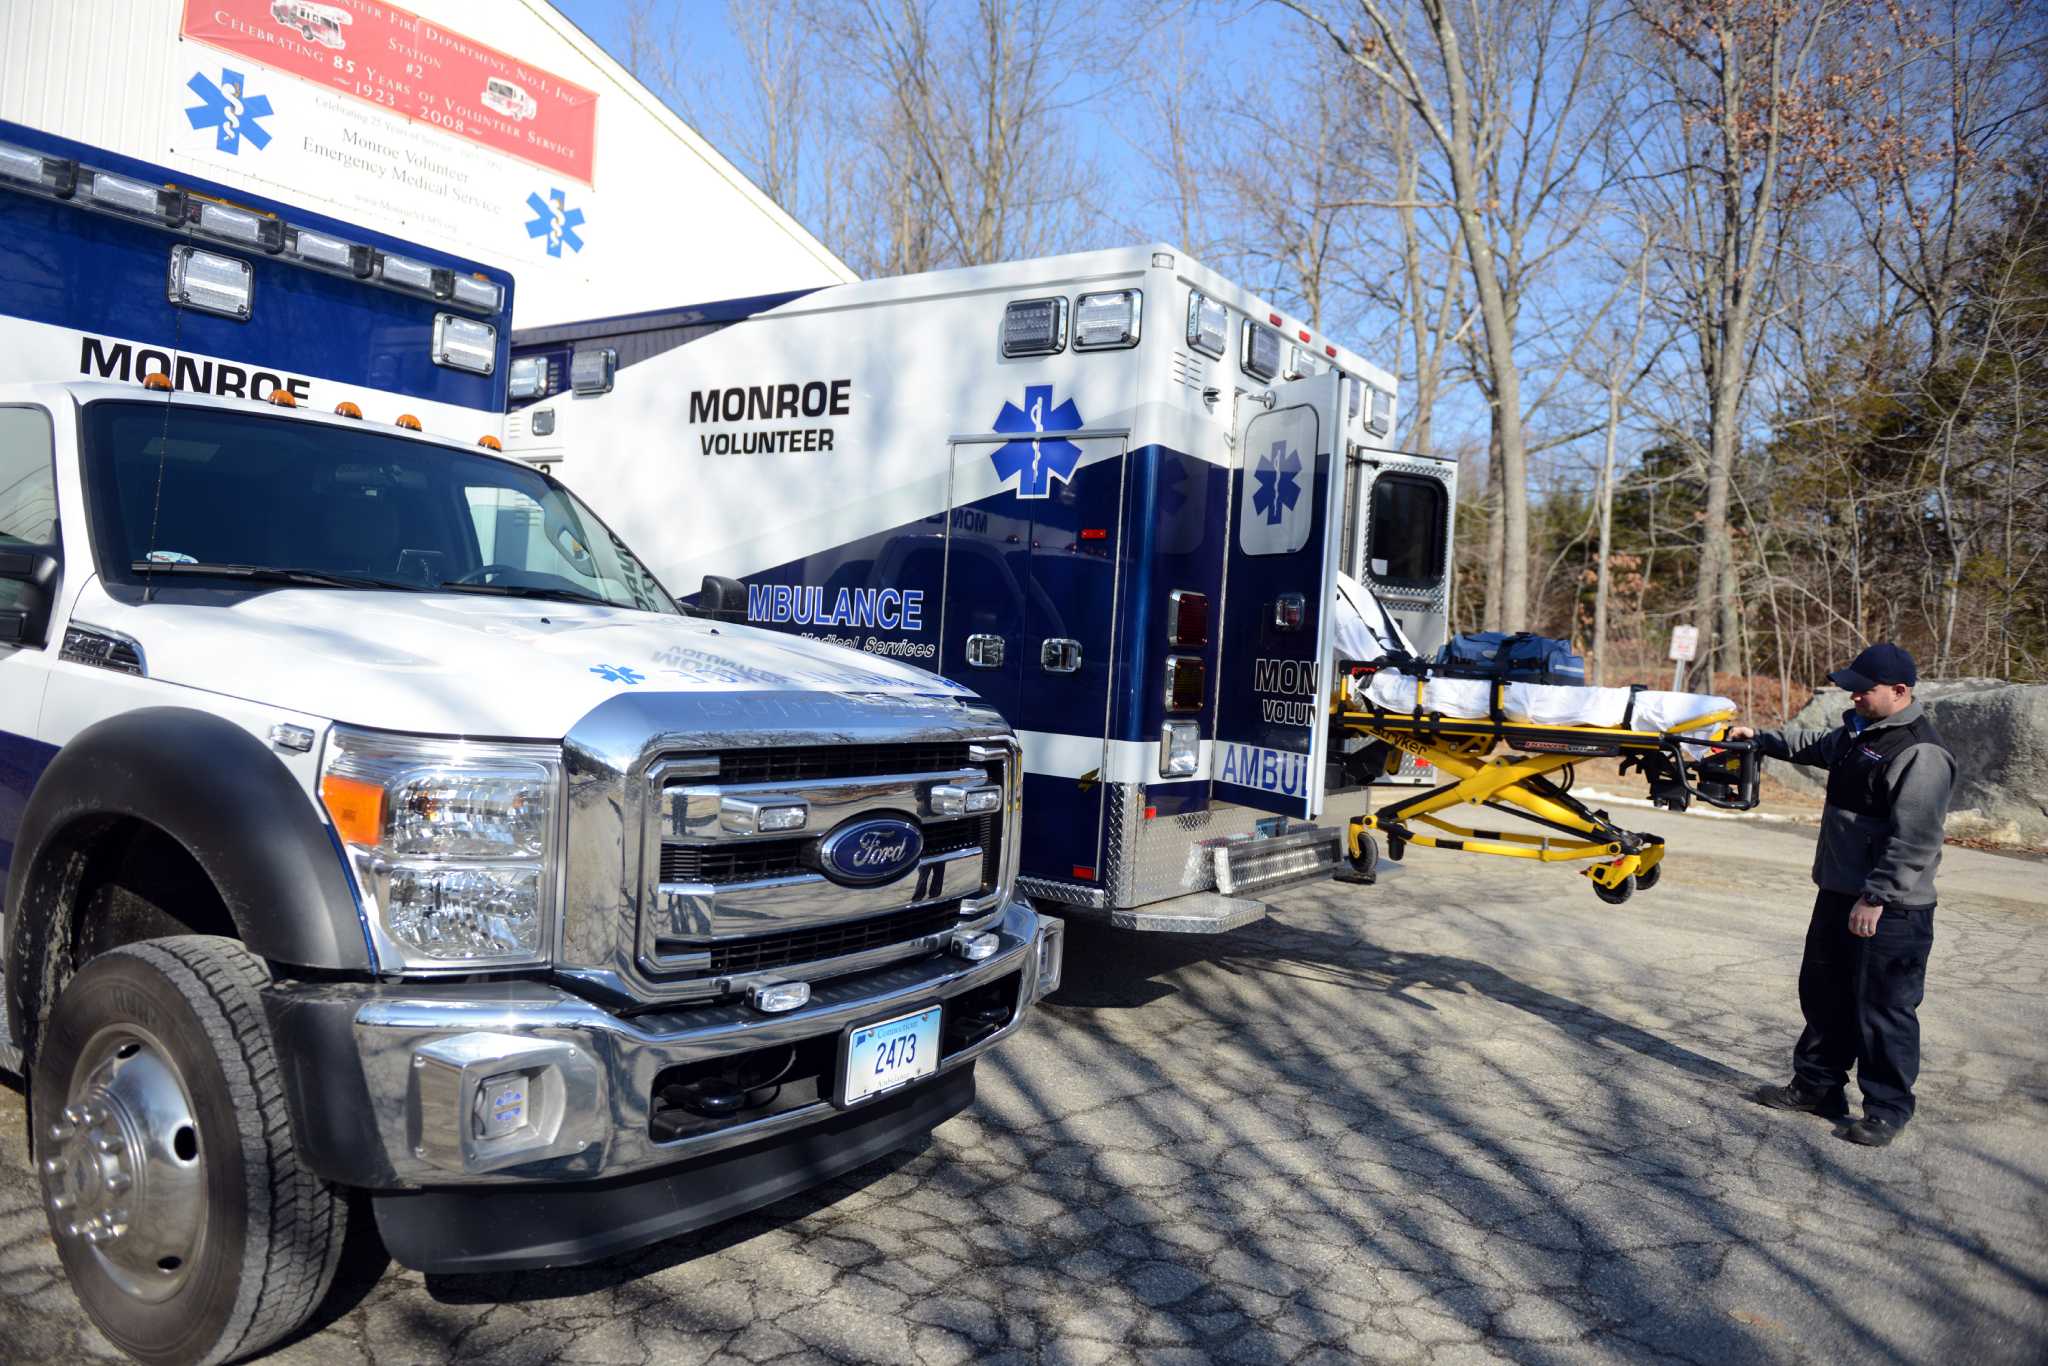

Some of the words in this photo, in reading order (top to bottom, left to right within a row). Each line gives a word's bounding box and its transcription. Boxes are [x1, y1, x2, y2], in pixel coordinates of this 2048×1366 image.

[332, 54, 357, 73] 85
[406, 63, 424, 79] #2
[342, 128, 400, 160] Monroe
[404, 149, 471, 184] Volunteer
[303, 136, 388, 179] Emergency
[391, 166, 448, 198] Medical
[452, 186, 503, 216] Service
[80, 337, 311, 405] MONROE
[689, 379, 851, 424] MONROE
[700, 428, 834, 456] VOLUNTEER
[864, 636, 936, 658] Services
[853, 831, 906, 867] Ford
[875, 1033, 917, 1075] 2473
